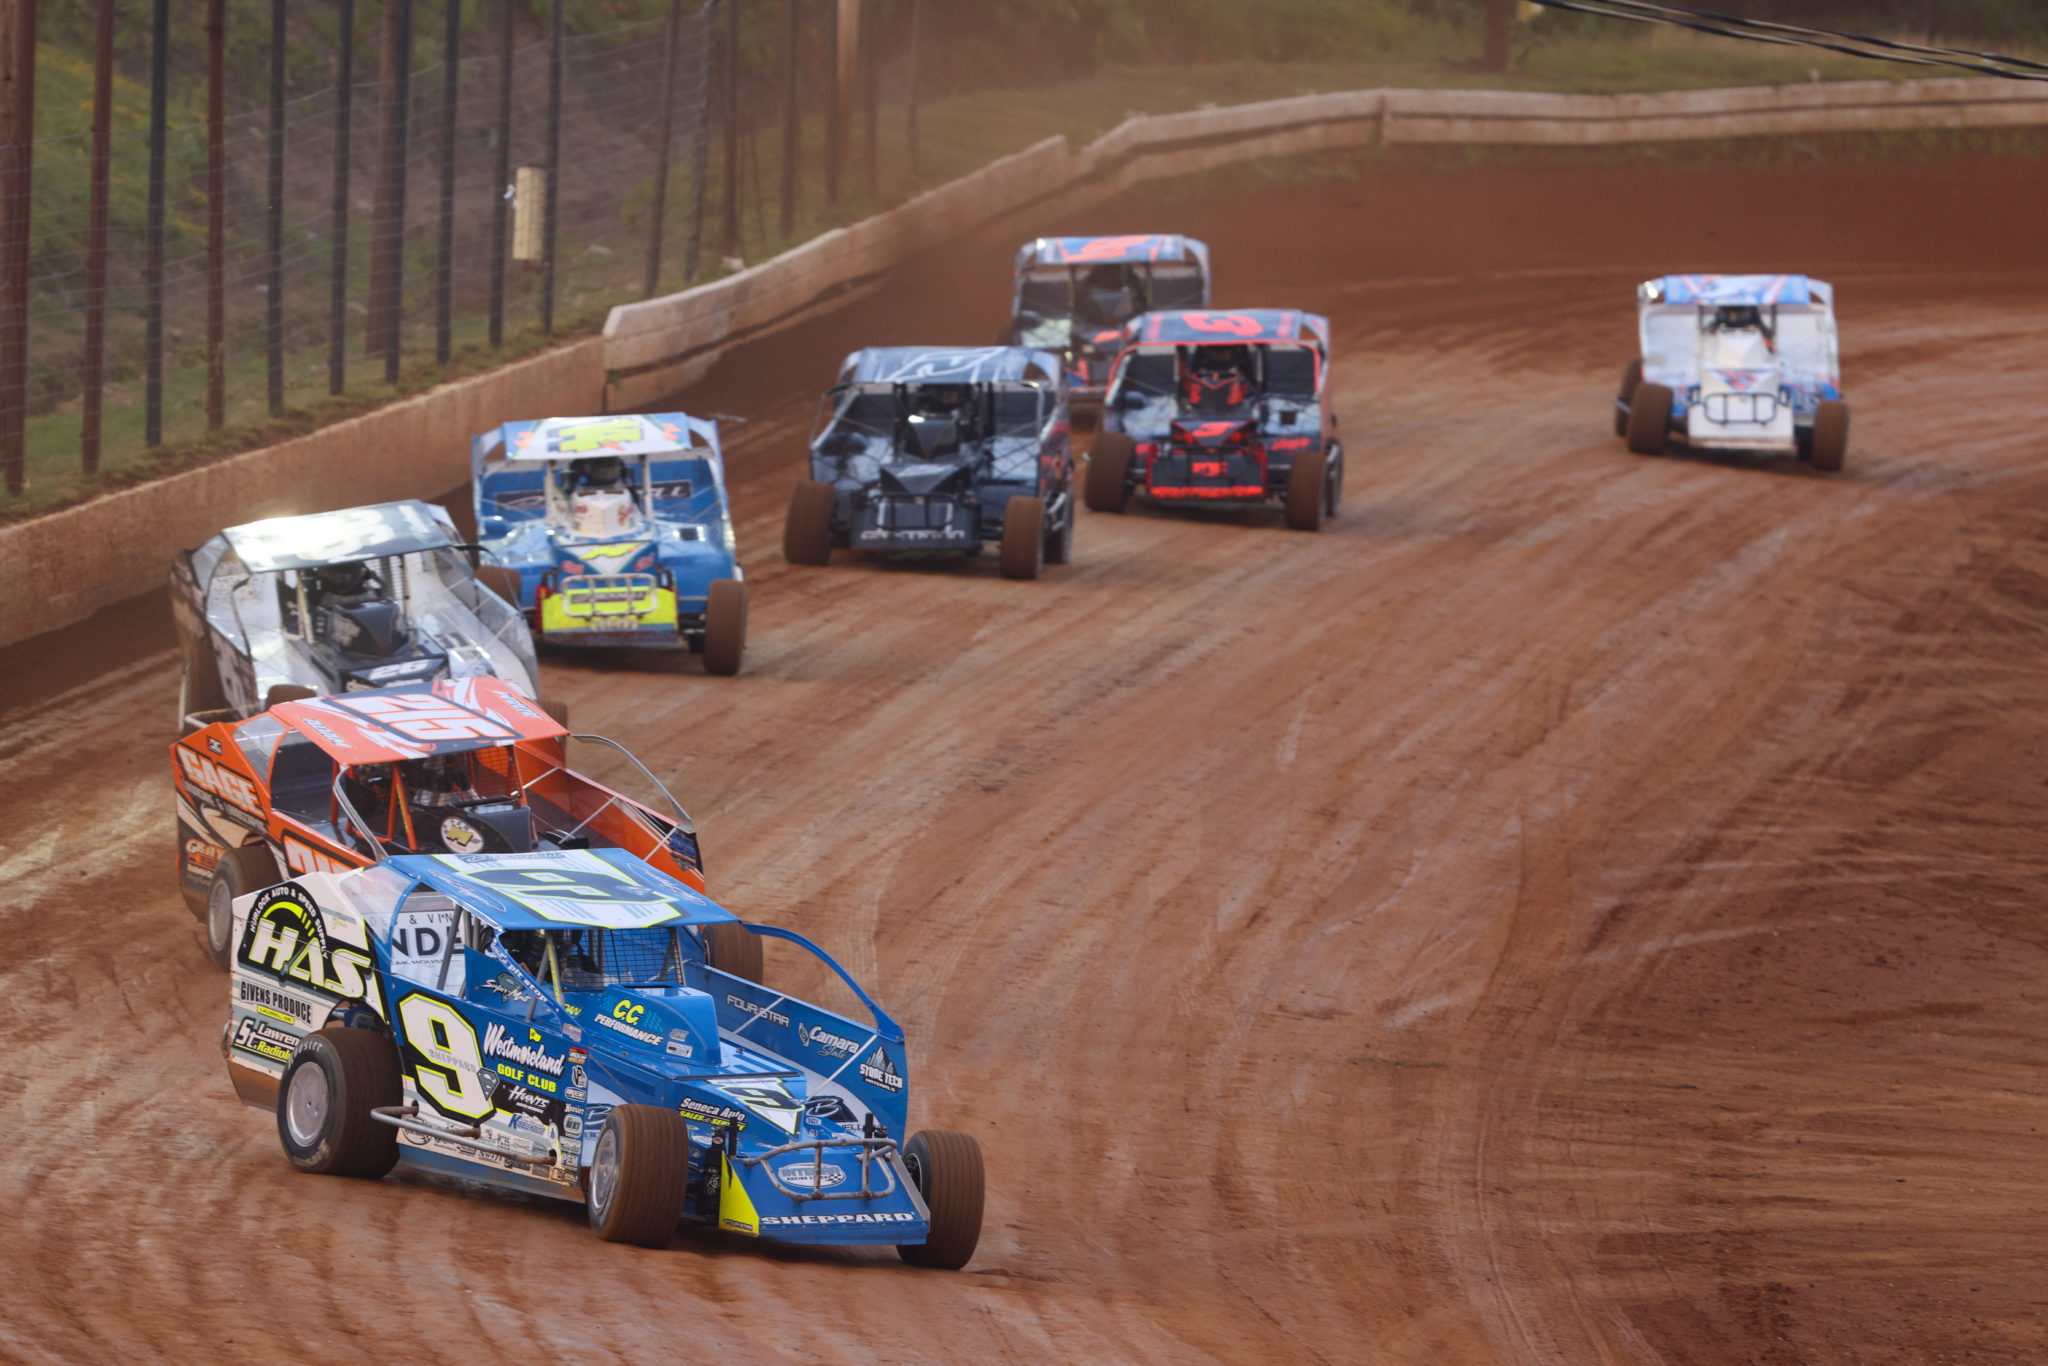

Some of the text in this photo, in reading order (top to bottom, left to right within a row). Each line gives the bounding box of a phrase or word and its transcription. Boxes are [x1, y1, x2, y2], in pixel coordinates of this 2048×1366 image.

[250, 887, 329, 960] HURLOCK AUTO & SPEED SUPPLY
[409, 914, 417, 925] &
[248, 917, 371, 998] HAS
[241, 981, 311, 1024] GIVENS PRODUCE
[257, 1023, 301, 1046] Lawren
[594, 1013, 664, 1046] PERFORMANCE
[809, 1025, 860, 1054] Camara
[257, 1041, 292, 1060] Radiol
[397, 991, 496, 1120] 9
[428, 1049, 477, 1073] SHEPPARD
[483, 1021, 566, 1077] Westmoreland
[497, 1063, 557, 1093] GOLF CLUB
[859, 1063, 884, 1083] STONE
[884, 1071, 903, 1089] TECH
[680, 1110, 705, 1121] SALES
[681, 1097, 720, 1115] Seneca
[761, 1212, 914, 1225] SHEPPARD
